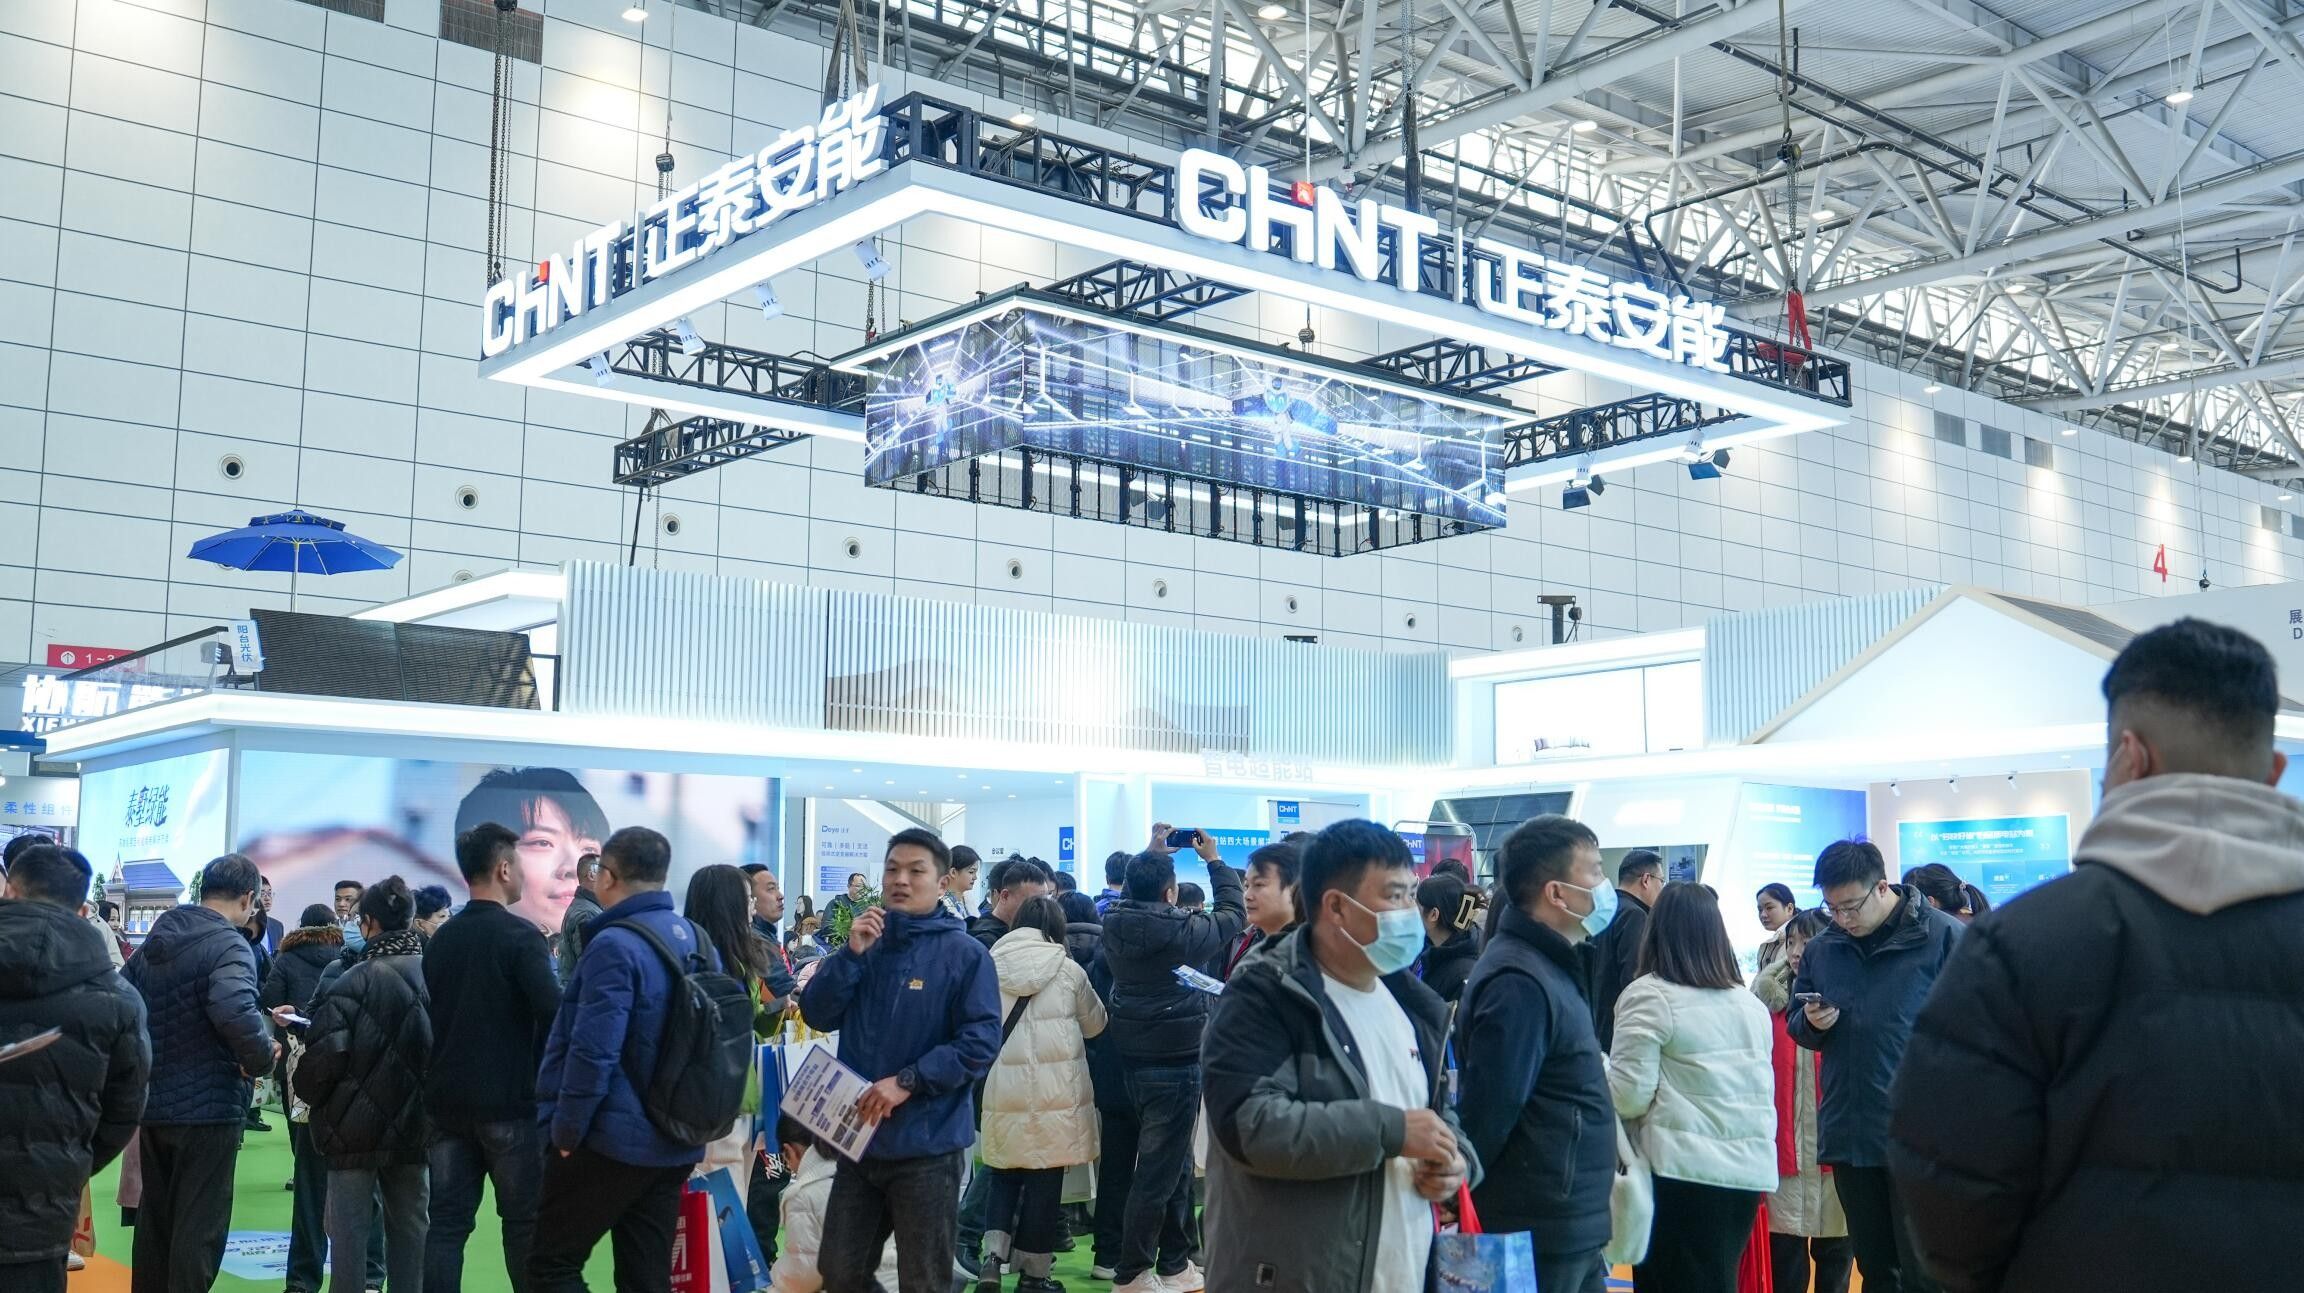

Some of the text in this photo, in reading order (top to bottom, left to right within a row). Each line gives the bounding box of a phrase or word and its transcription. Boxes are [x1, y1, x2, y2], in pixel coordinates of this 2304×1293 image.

[645, 82, 889, 279] 正泰安能
[1470, 237, 1732, 374] 正泰安能
[2153, 543, 2168, 583] 4
[237, 624, 254, 663] 阳台光伏
[4, 801, 73, 816] 柔性组件
